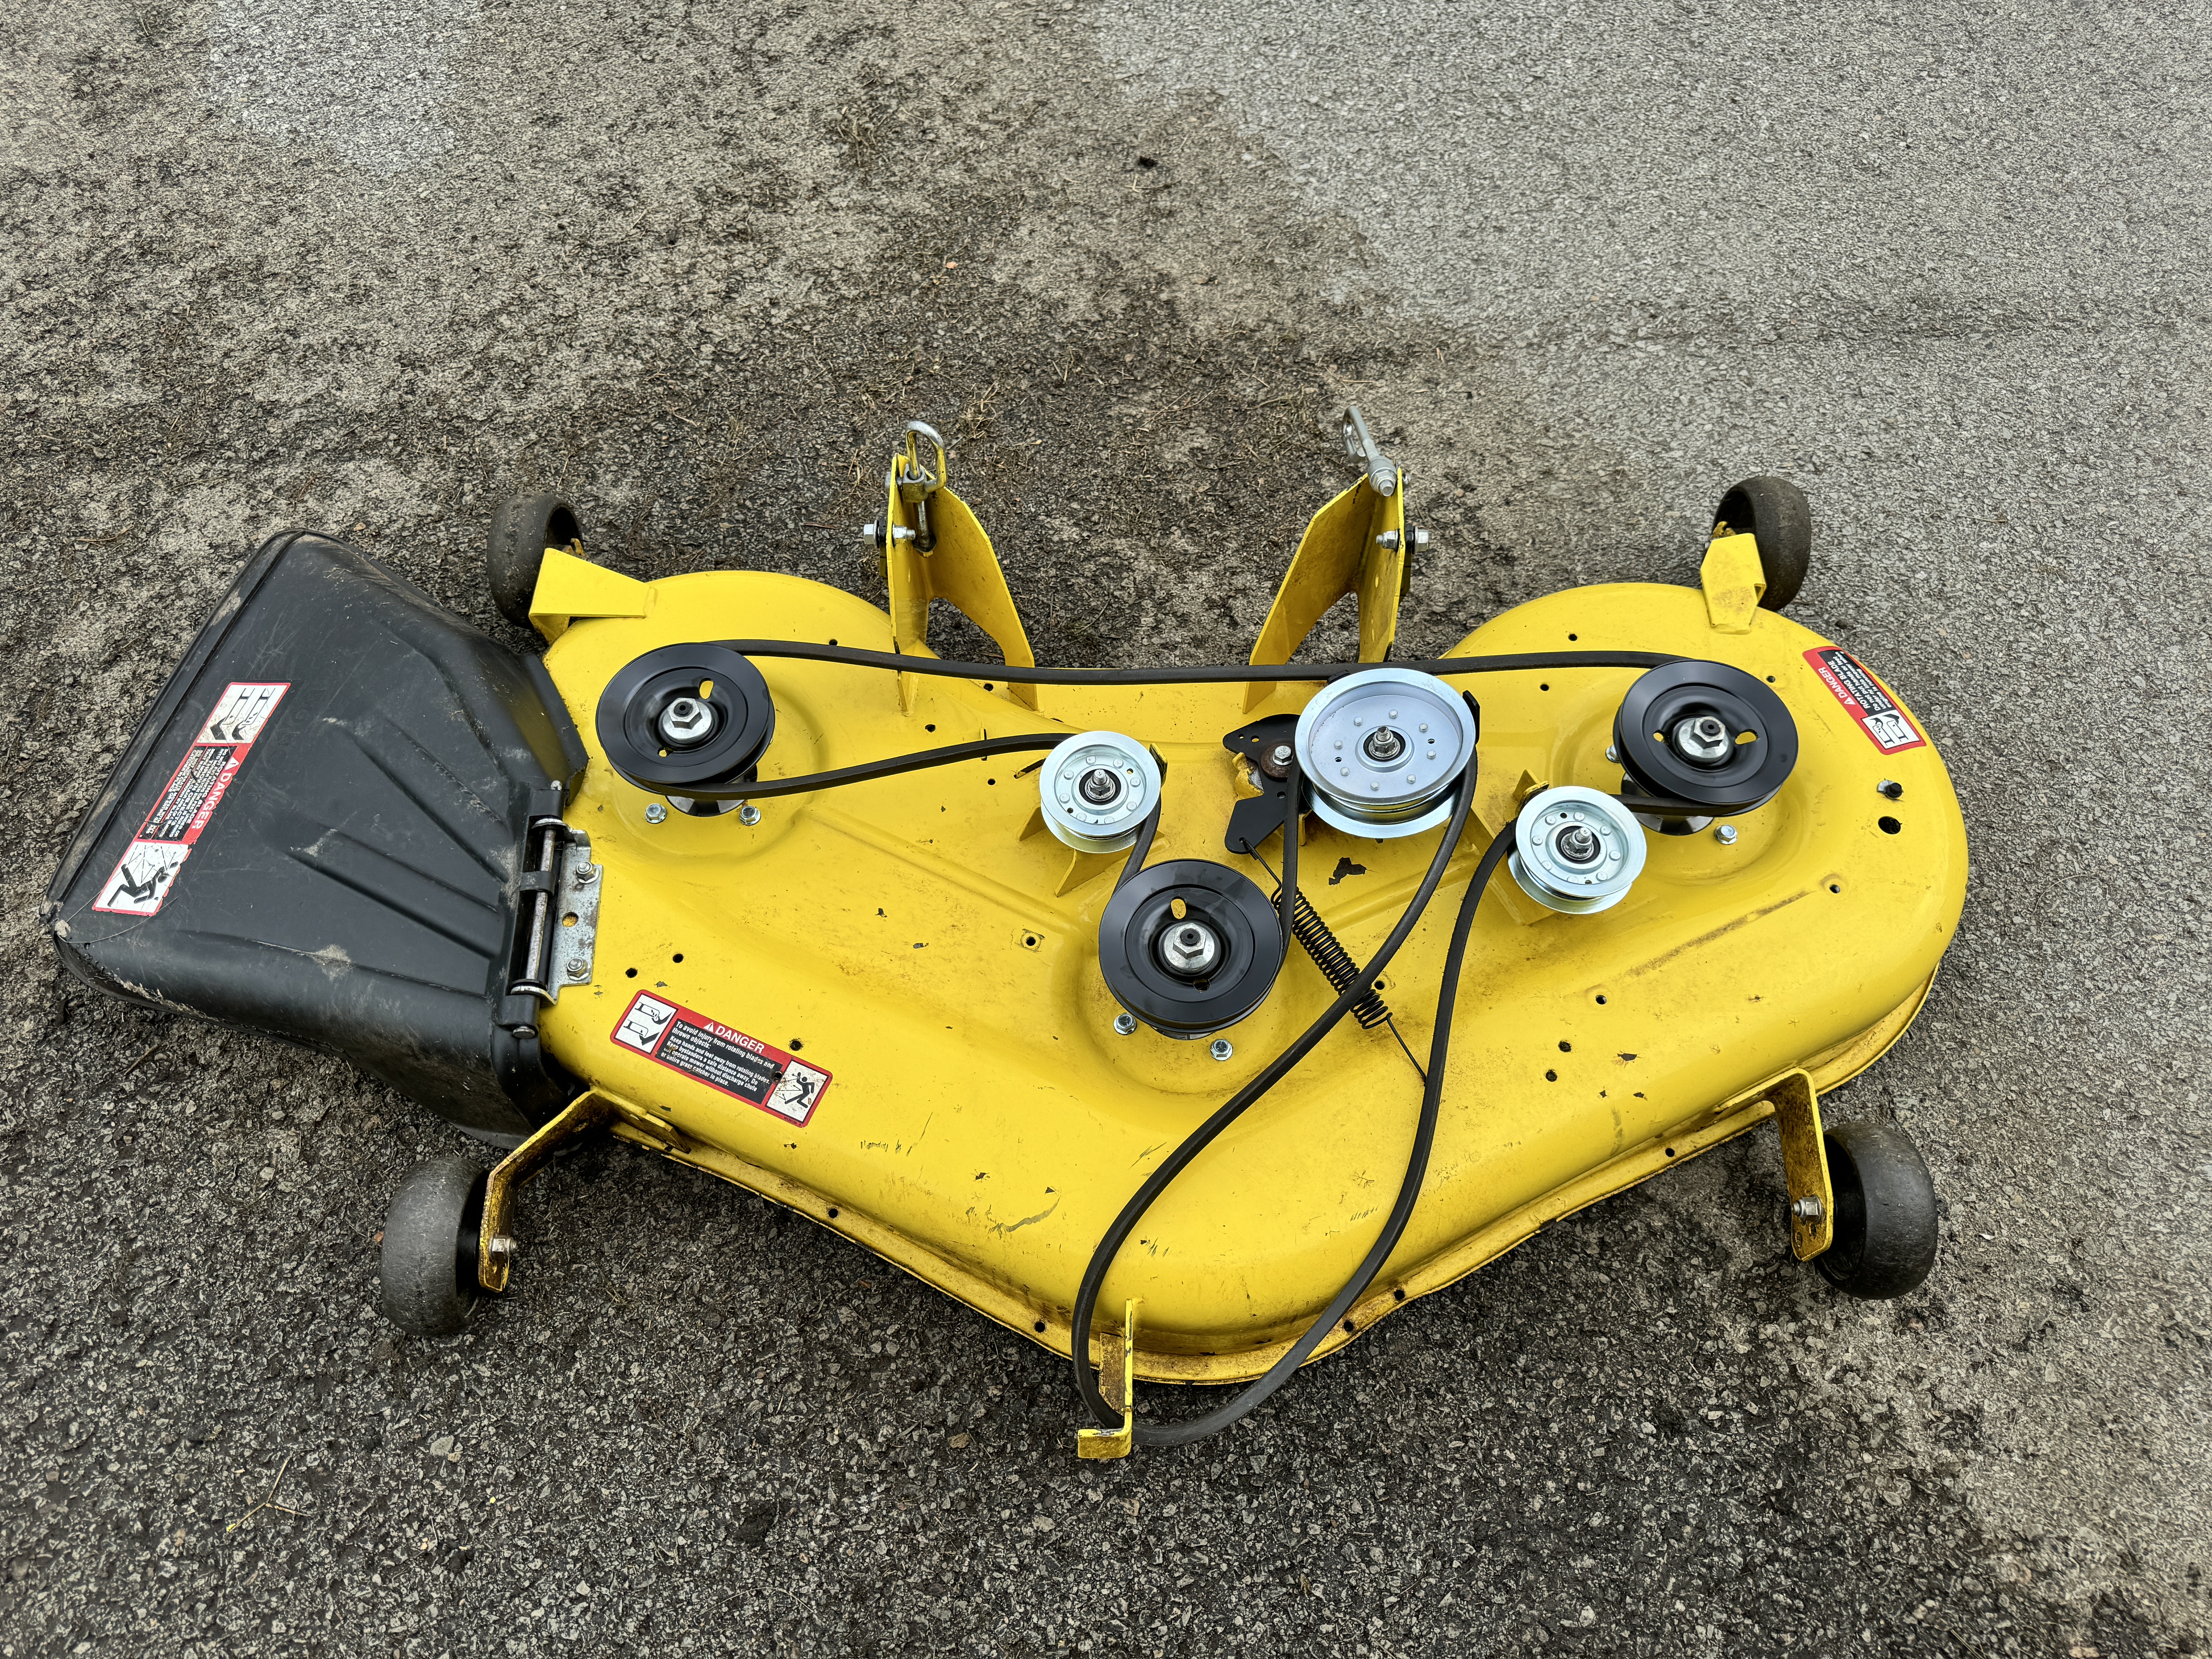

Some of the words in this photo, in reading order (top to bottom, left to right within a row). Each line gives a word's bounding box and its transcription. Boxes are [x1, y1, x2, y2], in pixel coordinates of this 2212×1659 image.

[1832, 656, 1843, 665] feet
[1834, 651, 1848, 663] when
[1827, 660, 1847, 680] BLADE
[1845, 663, 1861, 679] mower
[1846, 671, 1860, 686] hands
[1856, 668, 1874, 686] running
[1818, 667, 1848, 698] DANGER
[1857, 685, 1869, 694] put
[1859, 678, 1870, 689] into
[1843, 679, 1870, 709] ROTATING
[1864, 694, 1875, 703] not
[1872, 695, 1886, 709] under
[1876, 691, 1892, 708] engine
[1872, 703, 1881, 711] Do
[181, 749, 196, 771] CATCHER
[202, 748, 211, 761] THAT
[215, 748, 224, 759] INTO
[216, 756, 224, 766] NOT
[191, 759, 214, 791] THROWN
[205, 759, 218, 777] MOWER
[210, 766, 218, 775] PUT
[168, 776, 180, 792] PLACE
[171, 776, 184, 792] CHUTE
[200, 775, 212, 792] HANDS
[201, 761, 226, 798] ROTATING
[163, 792, 177, 810] MOWER
[171, 792, 193, 826] OBJECTS
[185, 792, 198, 810] ENGINE
[188, 800, 198, 813] FEET
[192, 773, 232, 829] DANGER
[186, 799, 203, 824] BLADE
[178, 813, 190, 830] UNDER
[672, 1027, 690, 1039] thrown
[690, 1036, 711, 1049] objects:
[682, 1025, 699, 1035] avoid
[697, 1031, 713, 1043] injury
[713, 1037, 726, 1048] from
[725, 1044, 746, 1057] rotating
[745, 1052, 764, 1065] blades
[715, 1025, 764, 1053] DANGER
[666, 1040, 679, 1049] Keep
[678, 1046, 703, 1060] bystanders
[717, 1063, 737, 1075] distance
[736, 1072, 749, 1082] away.
[669, 1035, 682, 1045] Keep
[681, 1041, 696, 1050] hands
[704, 1051, 714, 1059] feet
[713, 1056, 726, 1066] away
[725, 1060, 737, 1069] from
[736, 1066, 754, 1077] rotating
[753, 1073, 769, 1084] blades.
[666, 1054, 680, 1064] entire
[679, 1060, 693, 1069] grass
[692, 1066, 710, 1077] catcher
[714, 1076, 729, 1086] place.
[672, 1050, 689, 1061] operate
[689, 1058, 705, 1068] mower
[705, 1065, 722, 1076] without
[721, 1072, 744, 1085] discharge
[744, 1082, 757, 1092] chute
